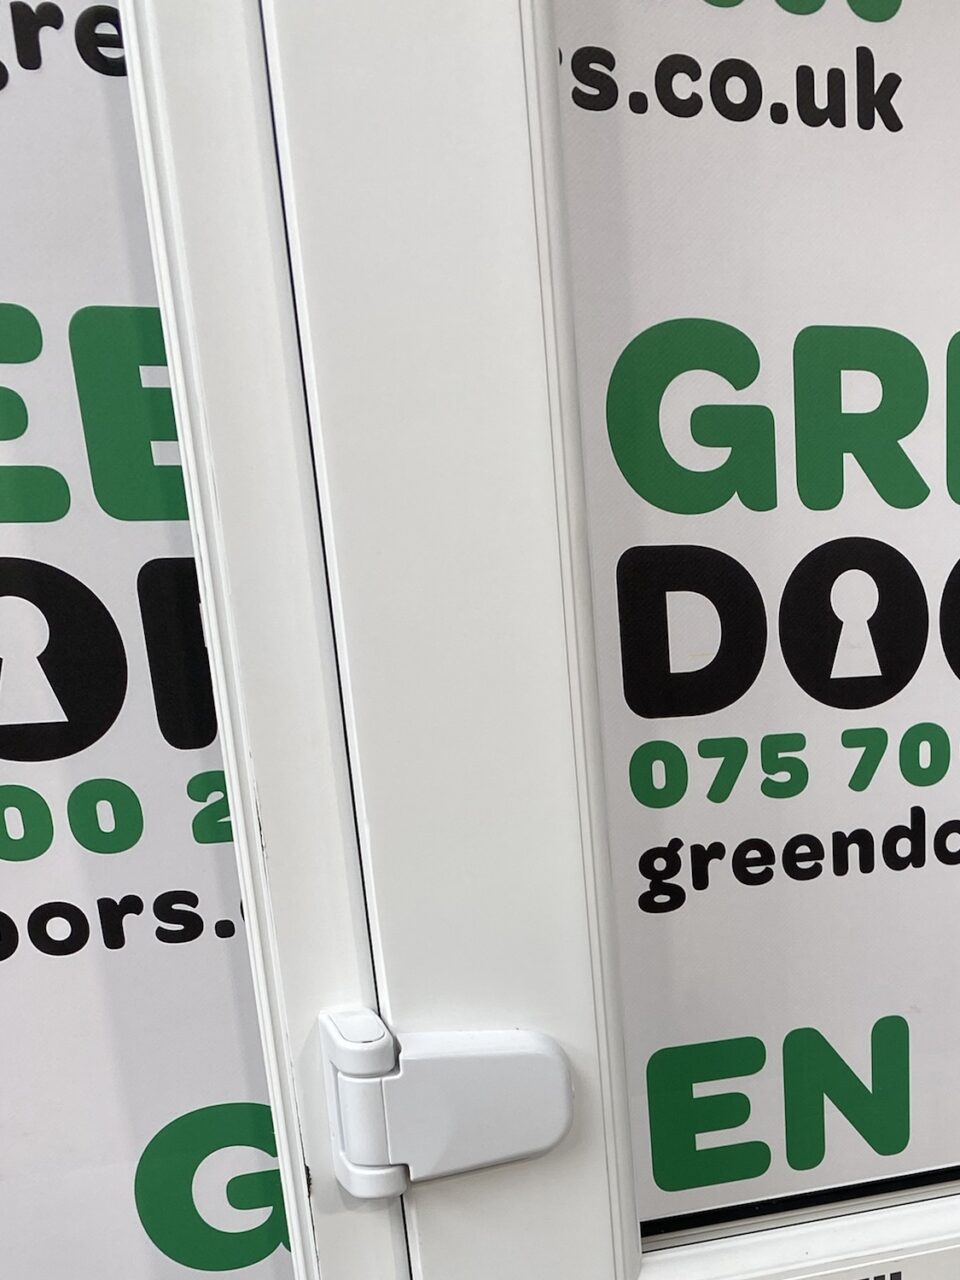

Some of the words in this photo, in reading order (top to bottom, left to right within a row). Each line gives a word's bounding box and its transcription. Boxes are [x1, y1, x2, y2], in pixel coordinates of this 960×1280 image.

[559, 45, 904, 133] s.co.uk
[628, 731, 810, 809] 075
[0, 890, 246, 962] ors.
[645, 1014, 912, 1193] EN
